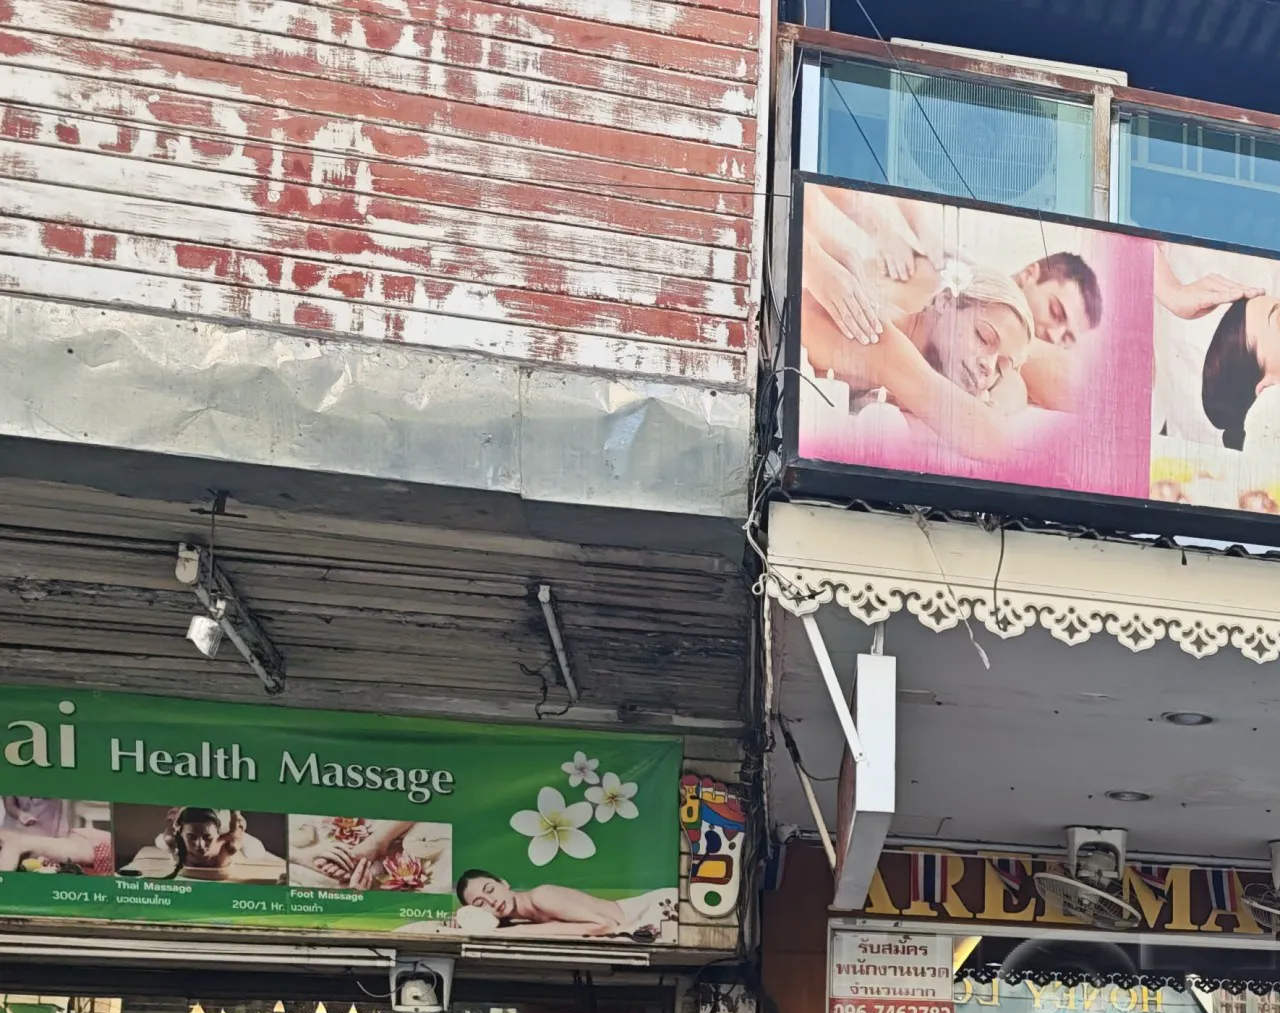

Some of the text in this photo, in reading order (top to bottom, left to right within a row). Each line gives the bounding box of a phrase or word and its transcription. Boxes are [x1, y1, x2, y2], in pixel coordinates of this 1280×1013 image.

[110, 738, 258, 782] Health
[279, 751, 456, 803] Massage
[116, 880, 192, 894] Thai Massage
[52, 890, 90, 902] 300/1
[290, 889, 364, 902] Foot Massage
[232, 900, 285, 911] 200/1 Hr.
[399, 907, 433, 919] 200/1
[858, 934, 928, 957] รับสมัคร
[836, 958, 950, 979] พนักงานนวด
[849, 981, 936, 998] จำนวนมาก
